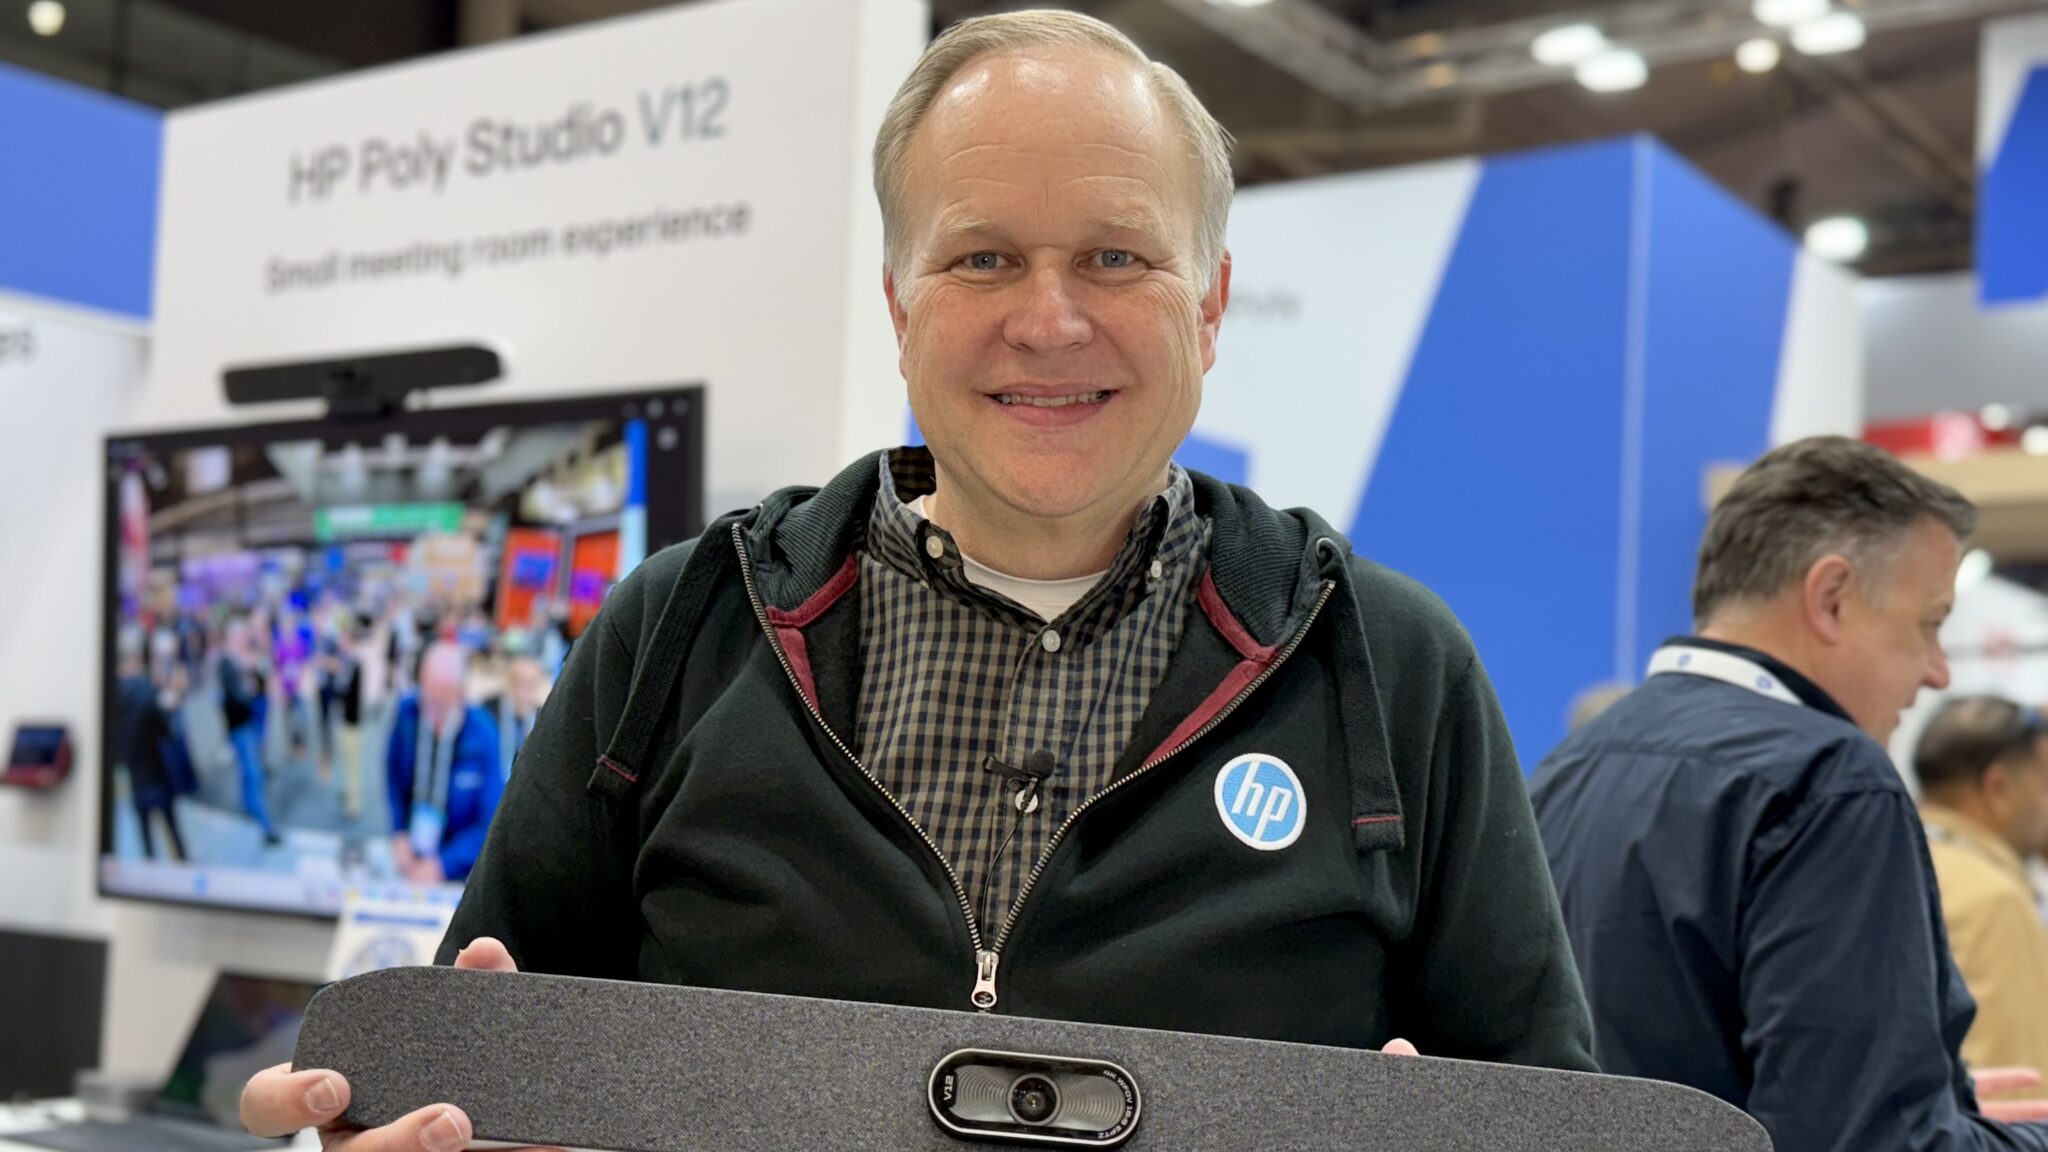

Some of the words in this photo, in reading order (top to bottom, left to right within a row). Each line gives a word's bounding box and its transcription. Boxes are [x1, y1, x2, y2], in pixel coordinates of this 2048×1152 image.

[287, 144, 351, 205] HP
[357, 131, 456, 198] Poly
[463, 101, 627, 180] Studio
[635, 78, 732, 148] V12
[264, 249, 340, 296] Small
[349, 239, 464, 283] meeting
[471, 228, 554, 270] room
[561, 201, 753, 259] experience
[1230, 758, 1295, 841] hp
[943, 1074, 955, 1101] V12
